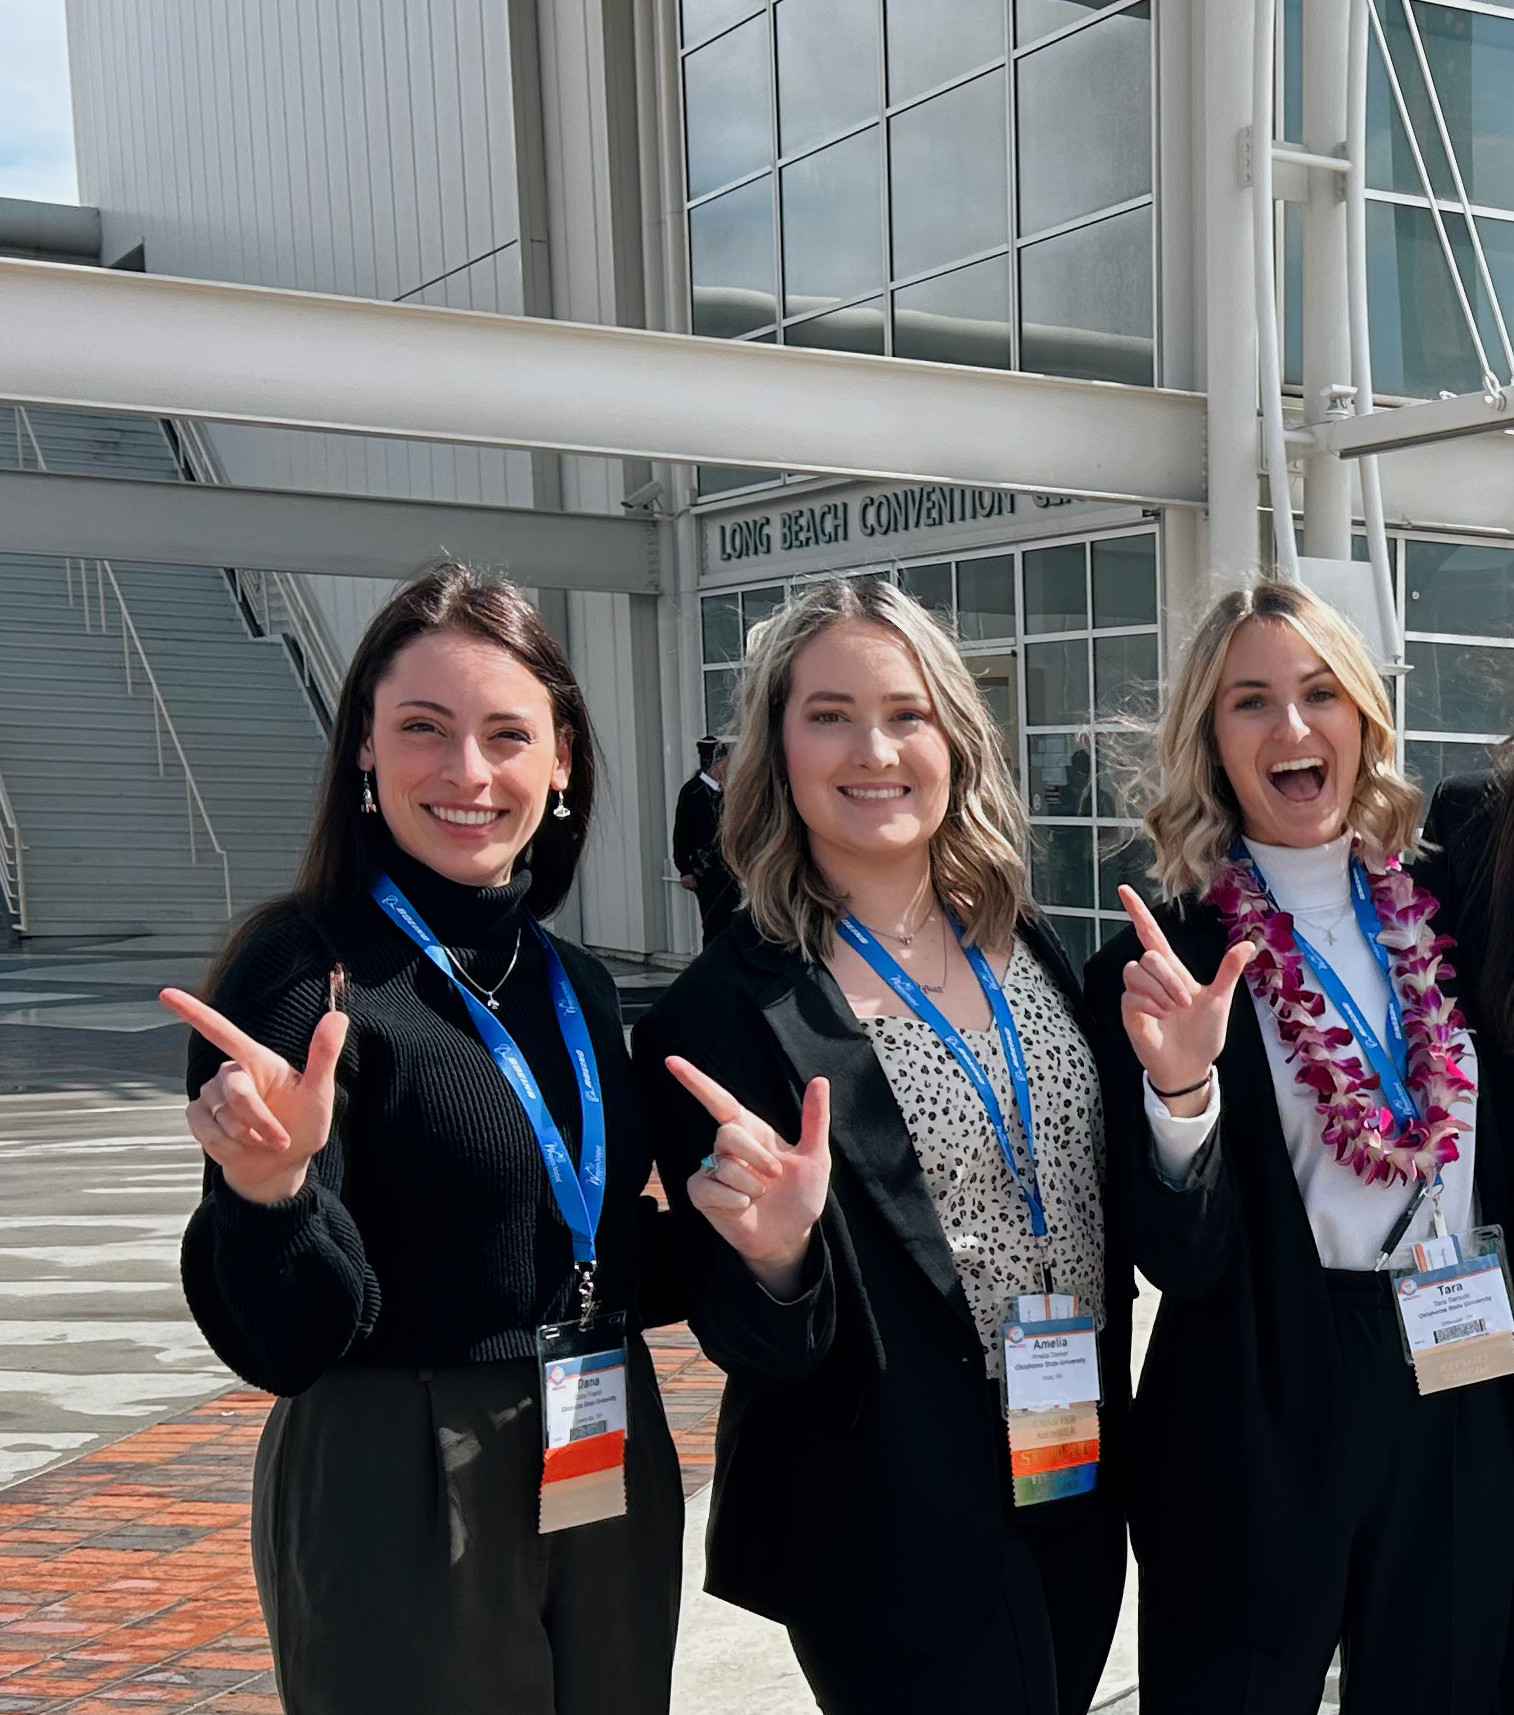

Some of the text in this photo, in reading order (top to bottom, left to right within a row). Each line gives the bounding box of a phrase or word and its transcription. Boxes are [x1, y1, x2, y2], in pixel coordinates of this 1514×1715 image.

[719, 486, 1015, 561] LONG BEACH CONVENTION
[507, 1055, 536, 1100] BOEING
[1437, 1282, 1464, 1296] Tara
[1033, 1338, 1068, 1350] Amelia
